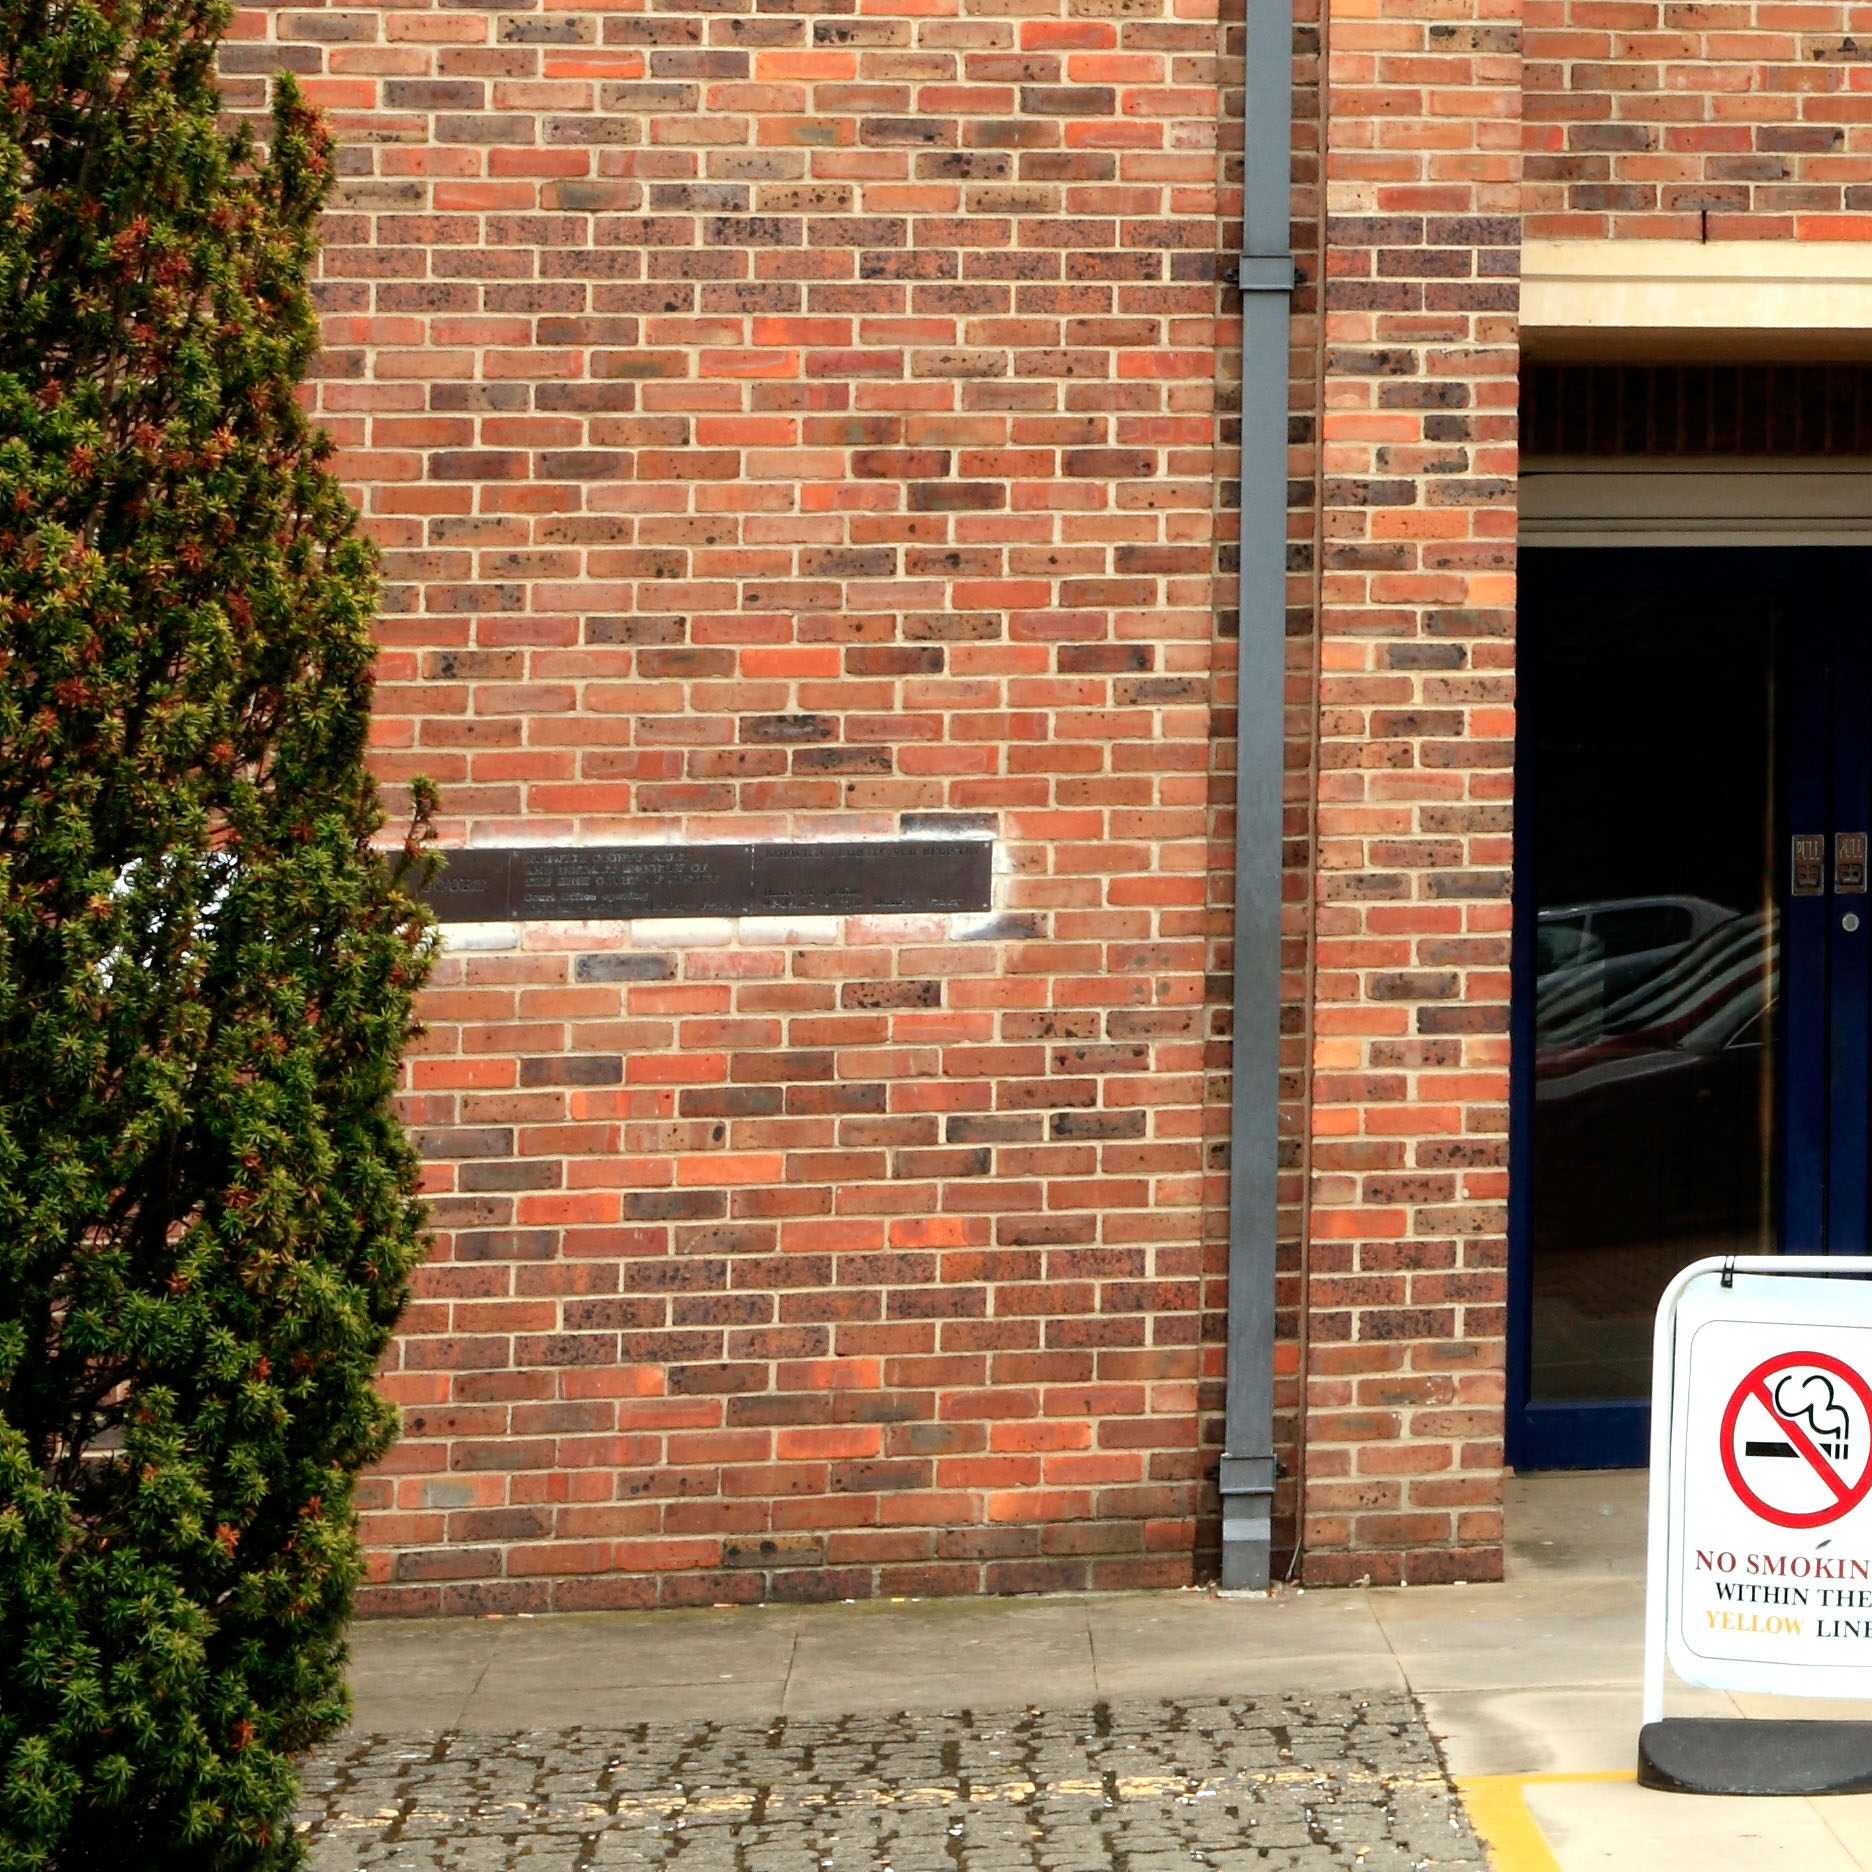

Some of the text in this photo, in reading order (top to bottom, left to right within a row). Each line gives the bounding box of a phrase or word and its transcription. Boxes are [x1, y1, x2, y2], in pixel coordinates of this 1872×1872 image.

[1695, 1549, 1736, 1573] NO
[1715, 1581, 1872, 1608] WITHIN THE
[1705, 1609, 1804, 1636] YELLOW
